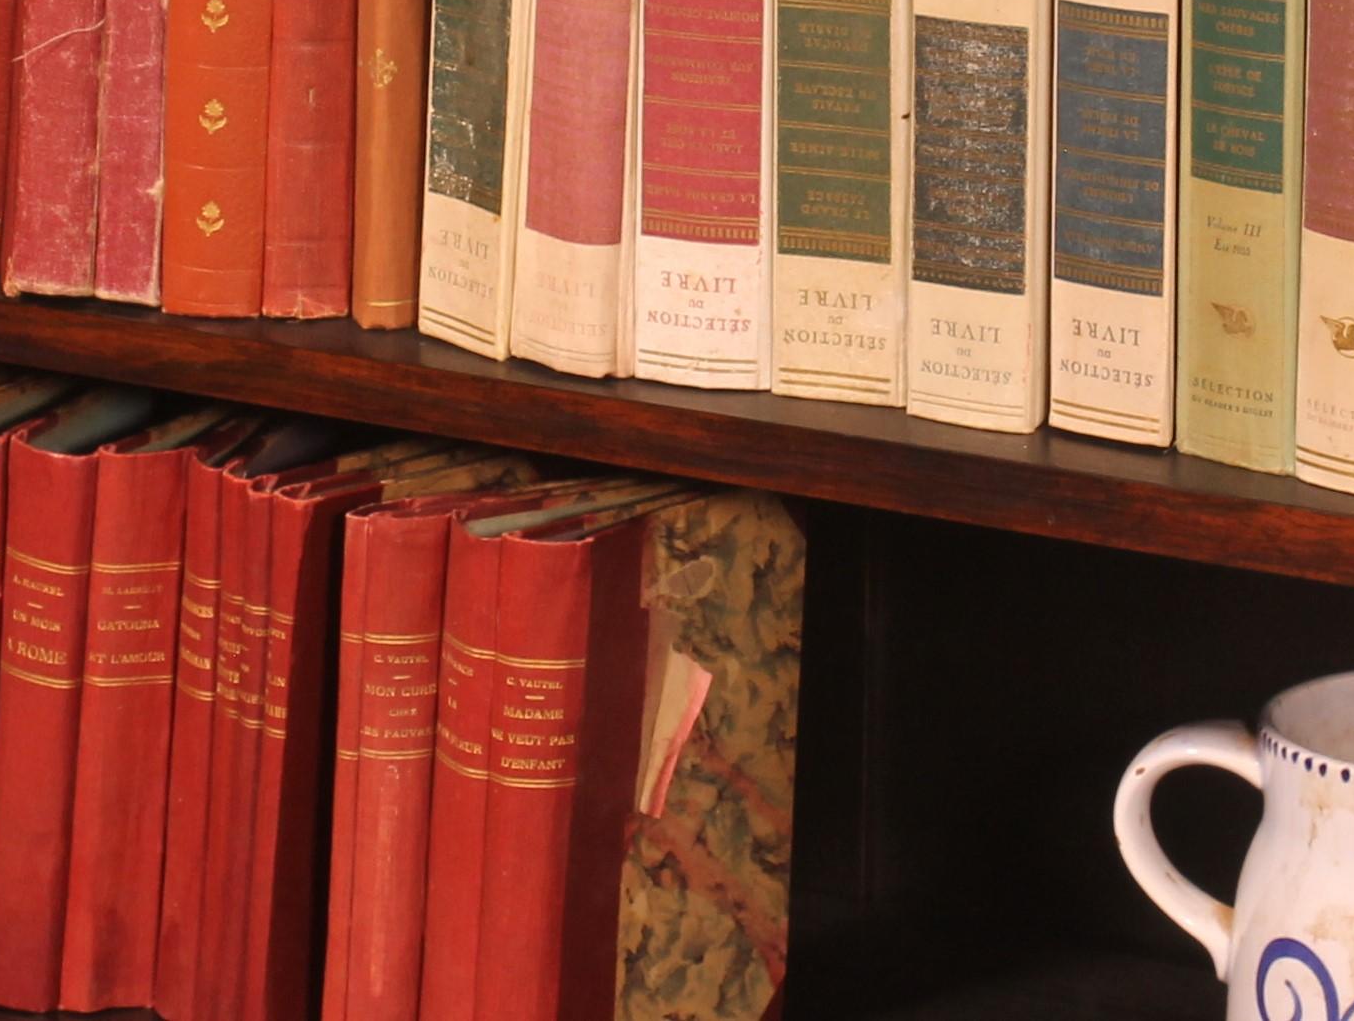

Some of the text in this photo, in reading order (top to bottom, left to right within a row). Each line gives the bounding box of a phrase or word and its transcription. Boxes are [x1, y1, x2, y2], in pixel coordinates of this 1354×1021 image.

[1244, 222, 1262, 238] III
[438, 229, 489, 260] LIVRE
[660, 270, 736, 295] LIVRE
[688, 298, 704, 310] DU
[797, 288, 872, 312] LIVRE
[646, 310, 752, 335] SÉLECTION
[827, 315, 843, 326] DU
[783, 328, 886, 351] SÉLECTION
[930, 318, 1000, 344] LIVRE
[1071, 318, 1140, 347] LIVRE
[956, 346, 972, 357] DU
[1096, 348, 1112, 359] DU
[920, 360, 1012, 386] SÉLECTION
[1060, 358, 1154, 389] SÉLECTION
[16, 640, 68, 666] ROME
[365, 683, 397, 698] MON
[518, 677, 564, 690] VAUTEL
[503, 704, 565, 720] MADAME
[507, 732, 546, 747] VEUT
[548, 733, 576, 747] PAS
[500, 755, 566, 771] D'ENFANT
